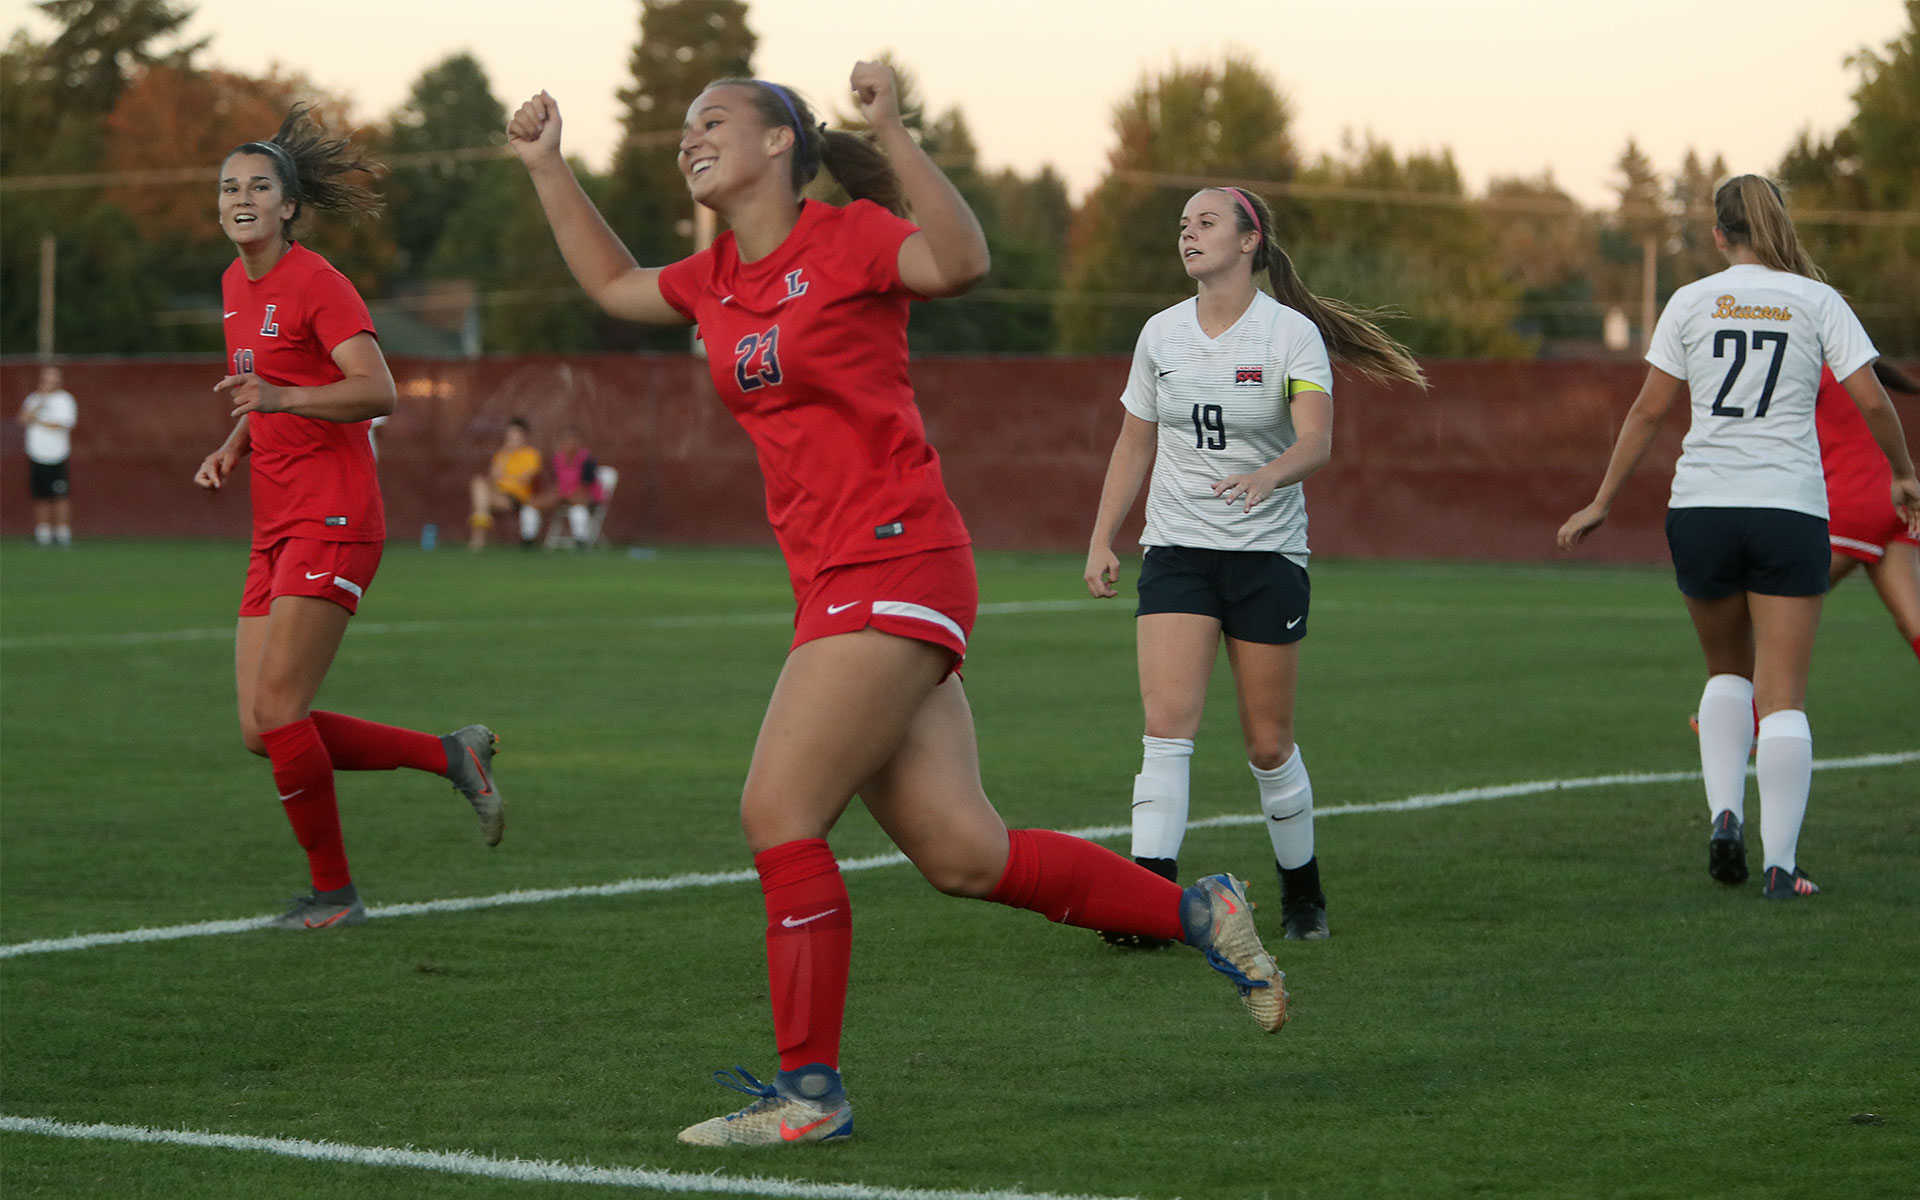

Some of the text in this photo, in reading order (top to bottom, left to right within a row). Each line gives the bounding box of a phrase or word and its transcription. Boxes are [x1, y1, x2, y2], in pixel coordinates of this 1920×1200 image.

[260, 304, 279, 337] L
[1712, 295, 1792, 320] Beacons
[735, 324, 783, 392] 23
[1711, 330, 1788, 418] 27
[1192, 404, 1226, 450] 19
